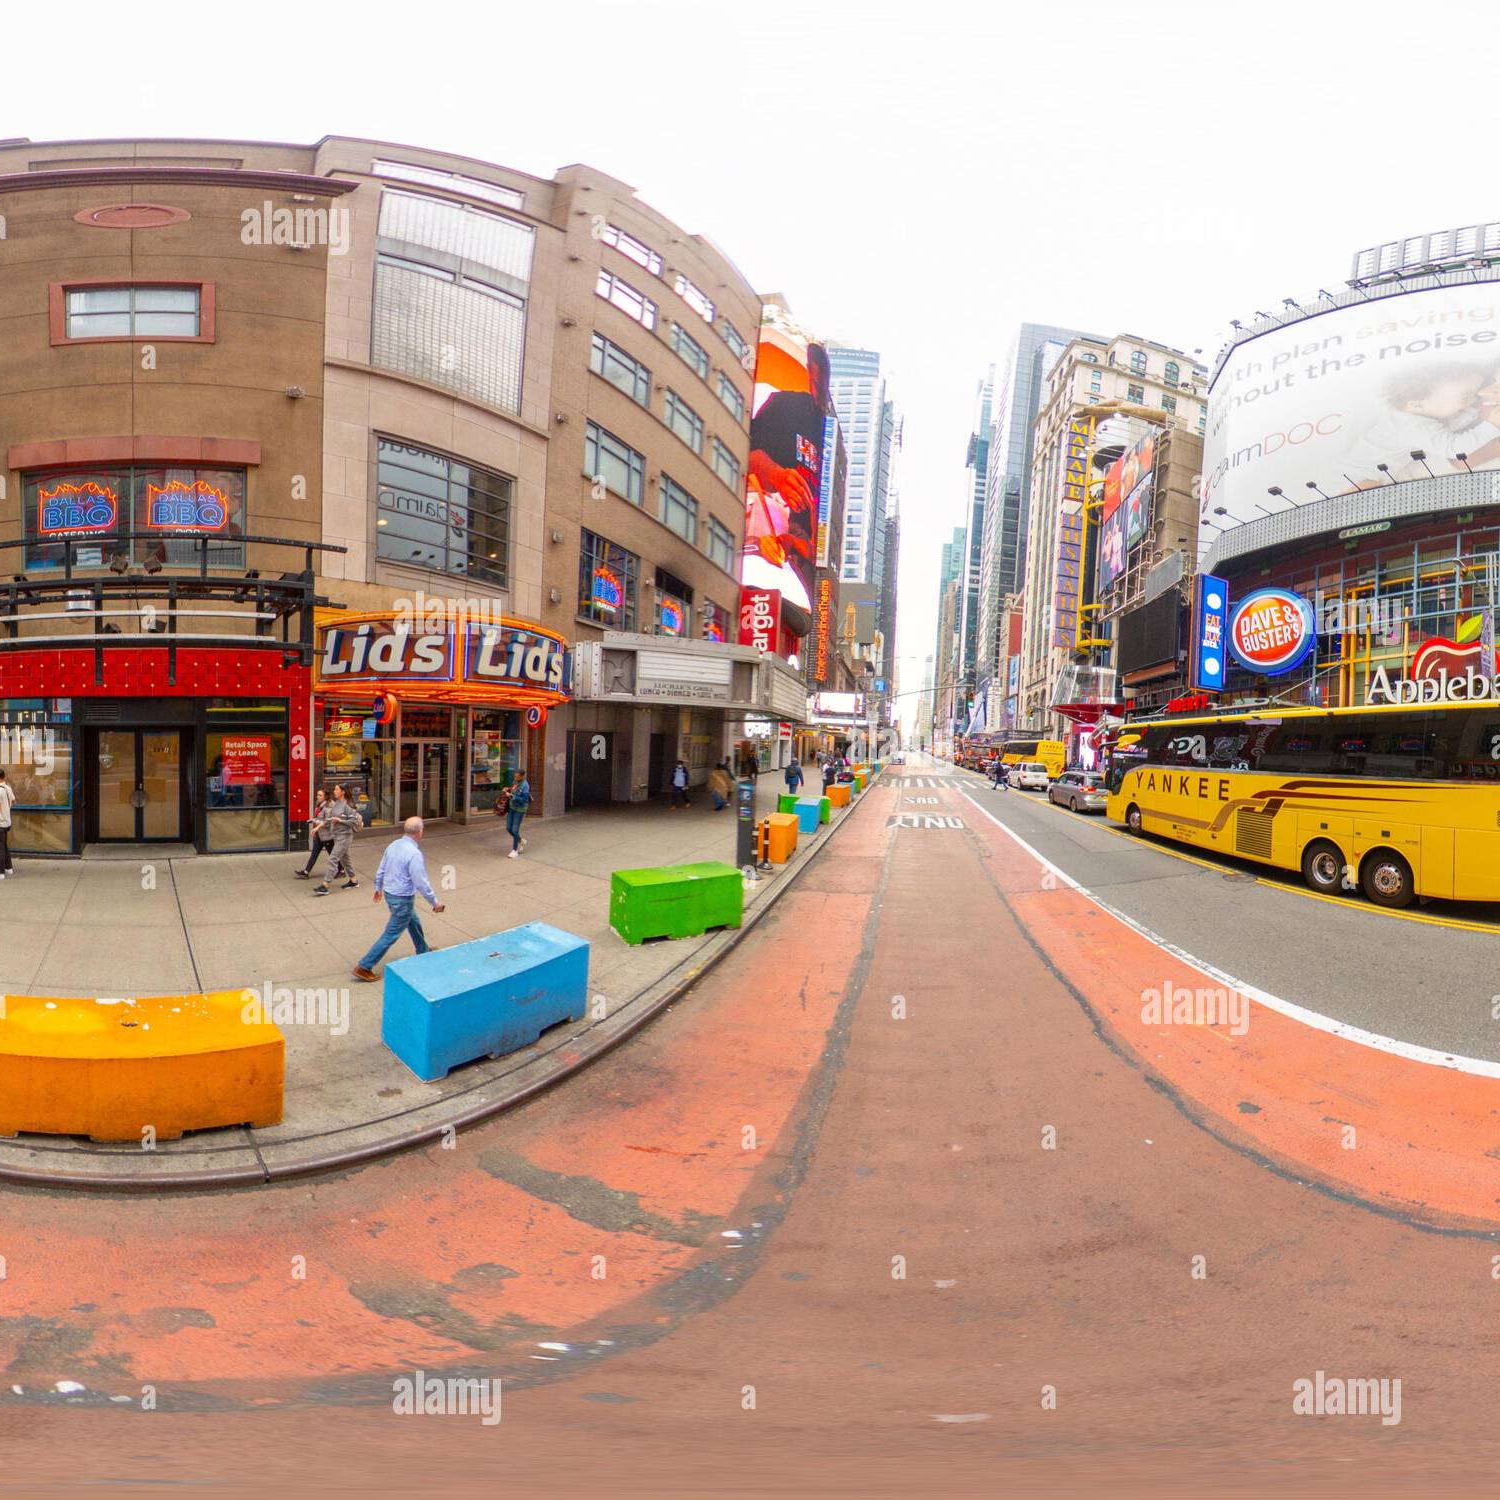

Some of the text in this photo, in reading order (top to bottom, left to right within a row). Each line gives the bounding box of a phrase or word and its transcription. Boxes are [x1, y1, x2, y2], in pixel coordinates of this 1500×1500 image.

[1272, 335, 1343, 371] plan
[1306, 353, 1367, 380] the
[1379, 330, 1498, 360] noise
[1064, 421, 1089, 500] MADAME
[49, 493, 107, 507] DALLAS
[158, 493, 218, 504] DALLAS
[42, 504, 114, 530] BBQ
[152, 502, 224, 528] BBQ
[751, 593, 775, 659] arget
[1240, 606, 1284, 637] DAVE
[1282, 605, 1298, 623] &
[1241, 621, 1301, 653] BUSTER'S
[321, 624, 445, 676] Lids
[476, 629, 563, 684] Lids
[225, 749, 238, 757] For
[246, 741, 268, 749] Space
[904, 796, 940, 805] BUS
[1135, 770, 1231, 802] YANKEE
[888, 816, 966, 830] ONLY
